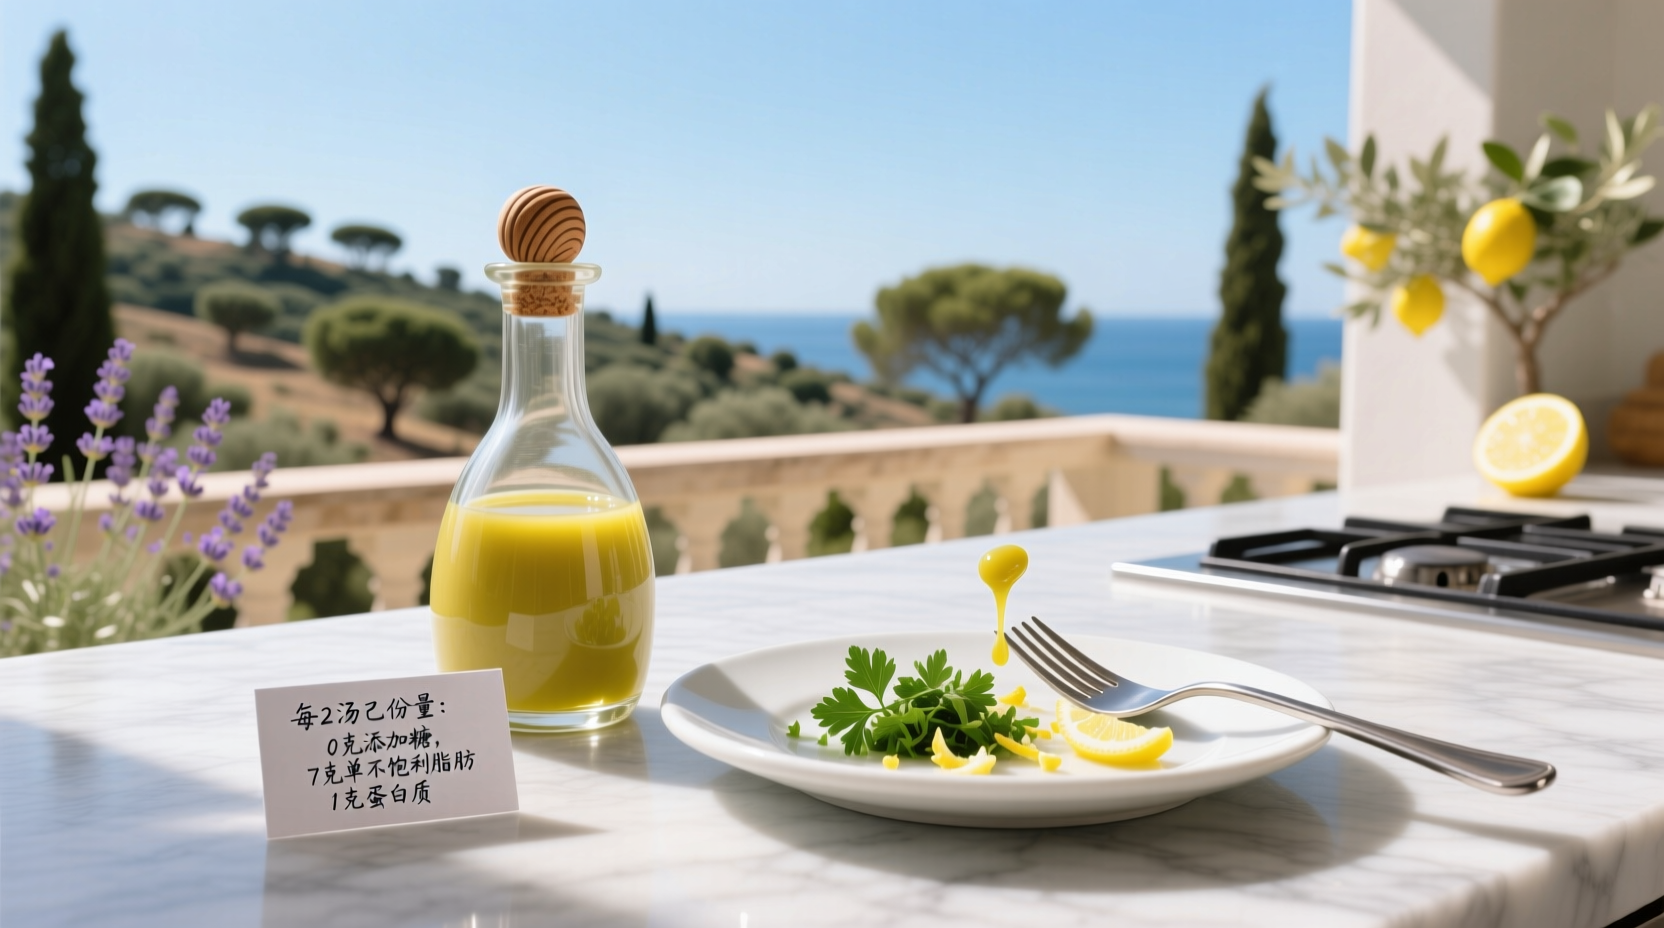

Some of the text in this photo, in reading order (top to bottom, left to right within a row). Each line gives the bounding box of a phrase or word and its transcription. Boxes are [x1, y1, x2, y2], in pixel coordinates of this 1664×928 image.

[307, 749, 475, 786] 7克单不饱利脂肪
[331, 779, 431, 811] 1克蛋白质
